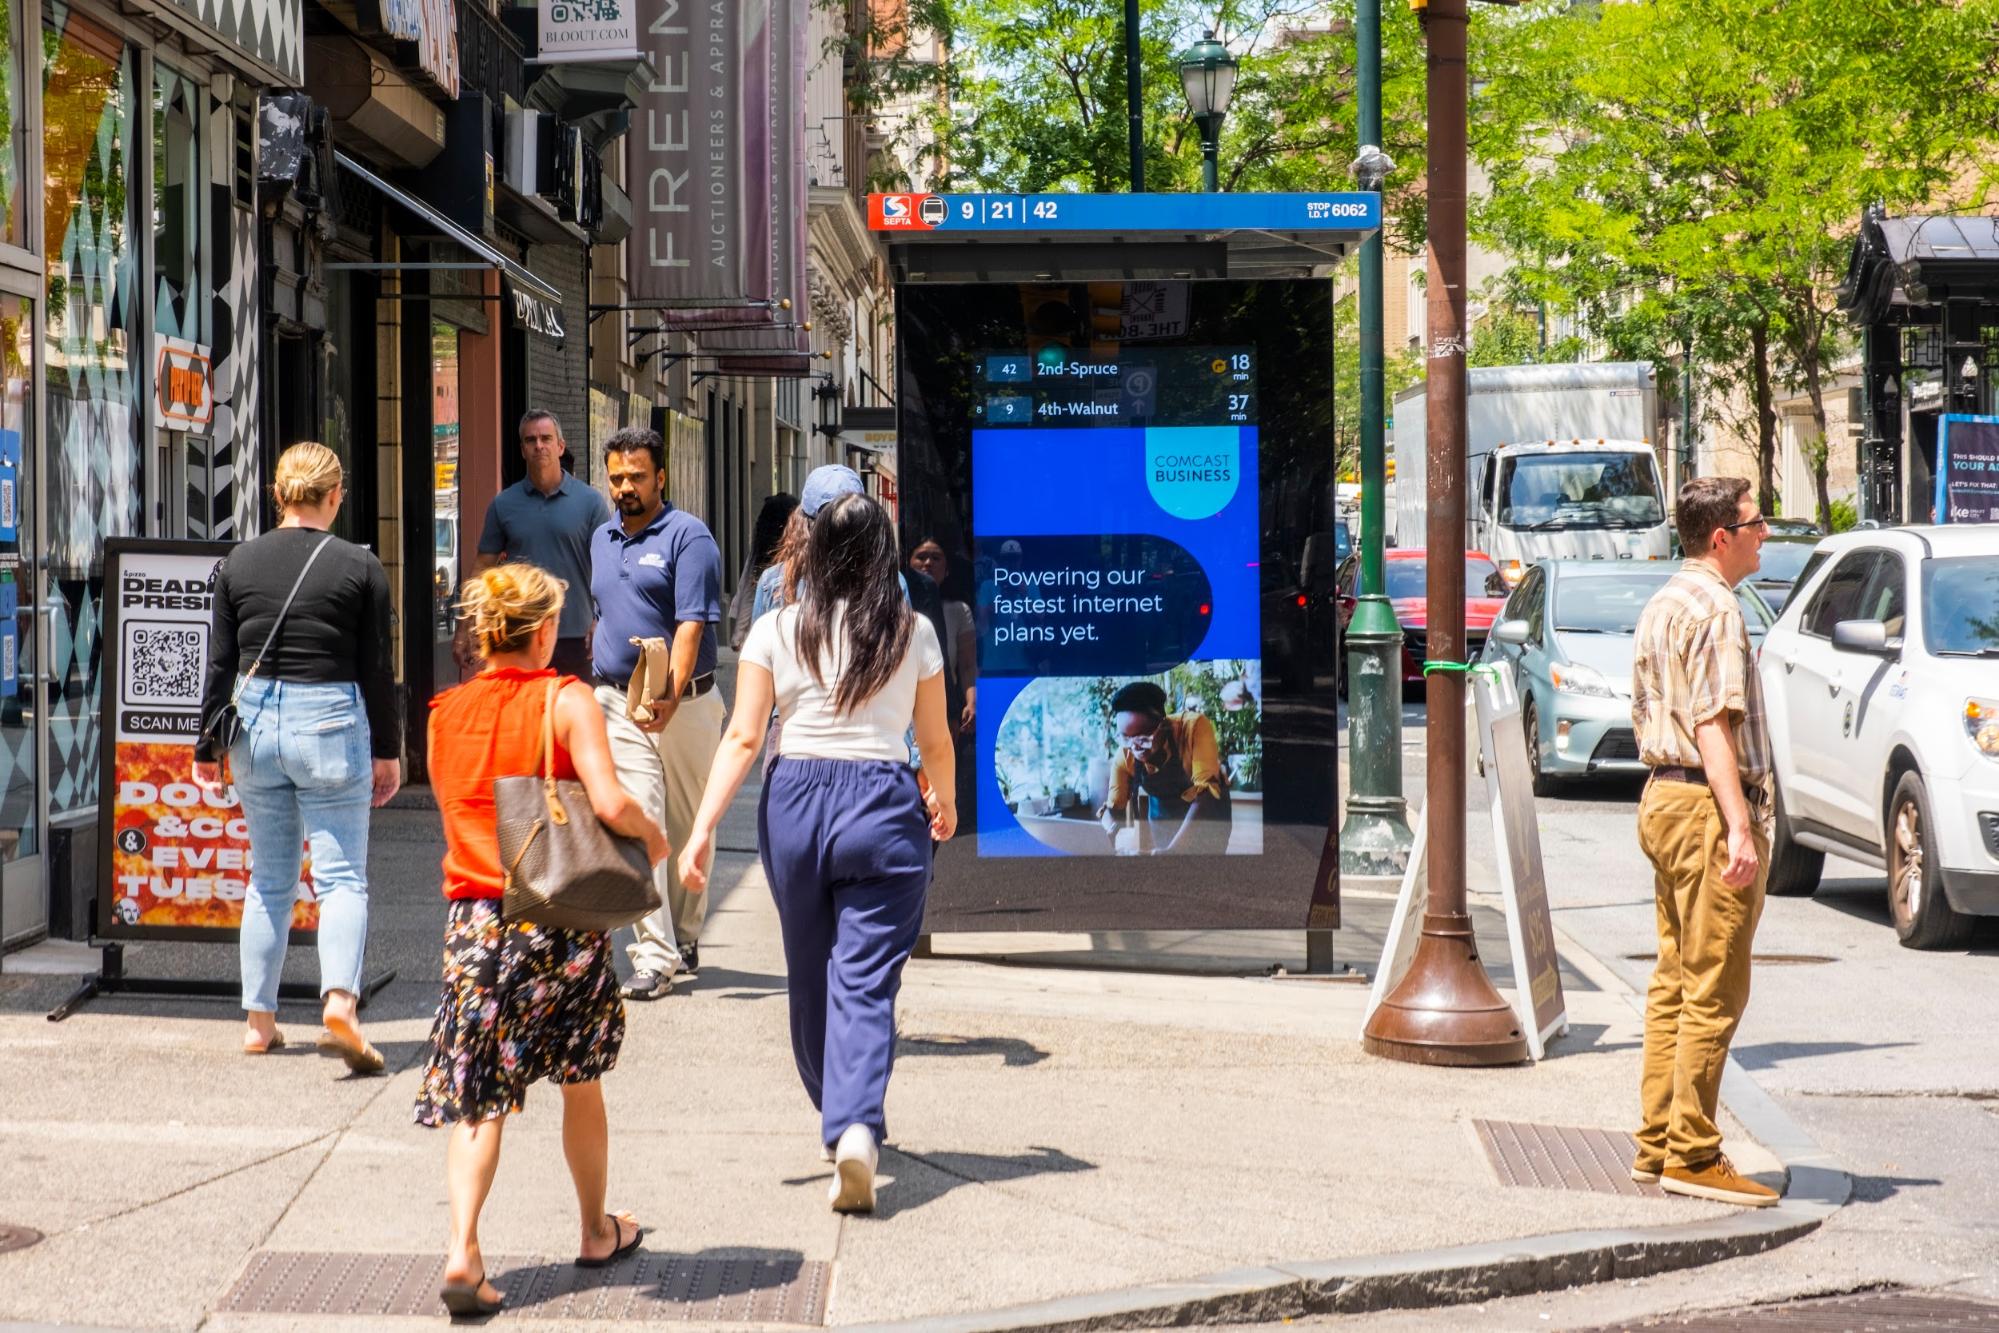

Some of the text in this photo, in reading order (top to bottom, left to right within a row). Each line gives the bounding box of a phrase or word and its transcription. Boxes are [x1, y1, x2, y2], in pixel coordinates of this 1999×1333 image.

[545, 28, 629, 43] BLOOUT.COM
[710, 85, 725, 99] &
[710, 109, 726, 268] AUCTIONEERS
[961, 201, 1058, 220] 9 21 42
[1307, 202, 1331, 211] STOP
[1331, 203, 1368, 217] 6062
[883, 217, 912, 226] SEPTA
[1308, 211, 1322, 219] I.D.
[975, 354, 1251, 379] 7 42 2nd-Spruce 18
[1233, 372, 1250, 381] min
[976, 394, 1250, 416] 8 9 4th-Walnut 37
[1230, 412, 1247, 421] min
[1154, 454, 1230, 468] COMCAST
[1968, 454, 1995, 462] SHOULD
[1952, 461, 1984, 472] YOUR
[1155, 469, 1231, 482] BUSINESS
[994, 567, 1146, 590] Powering our
[122, 594, 214, 611] PRESI
[993, 594, 1163, 614] fastest internet
[994, 622, 1099, 646] plans yet.
[130, 716, 200, 731] SCAN ME
[152, 846, 253, 870] EVE
